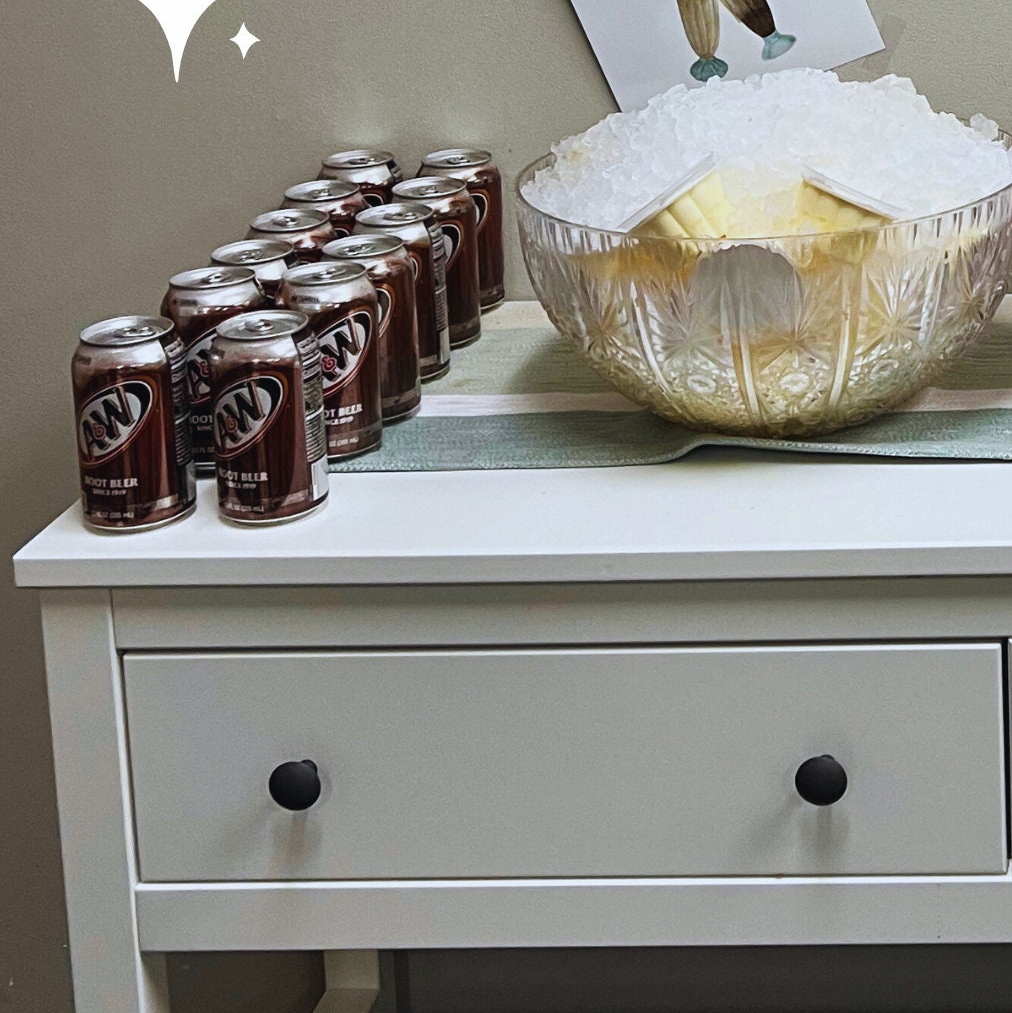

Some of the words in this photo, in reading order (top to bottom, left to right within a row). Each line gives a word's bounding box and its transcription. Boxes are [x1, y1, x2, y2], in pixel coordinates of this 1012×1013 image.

[338, 403, 363, 416] BEER
[110, 477, 139, 488] BEER
[241, 472, 268, 482] BEER
